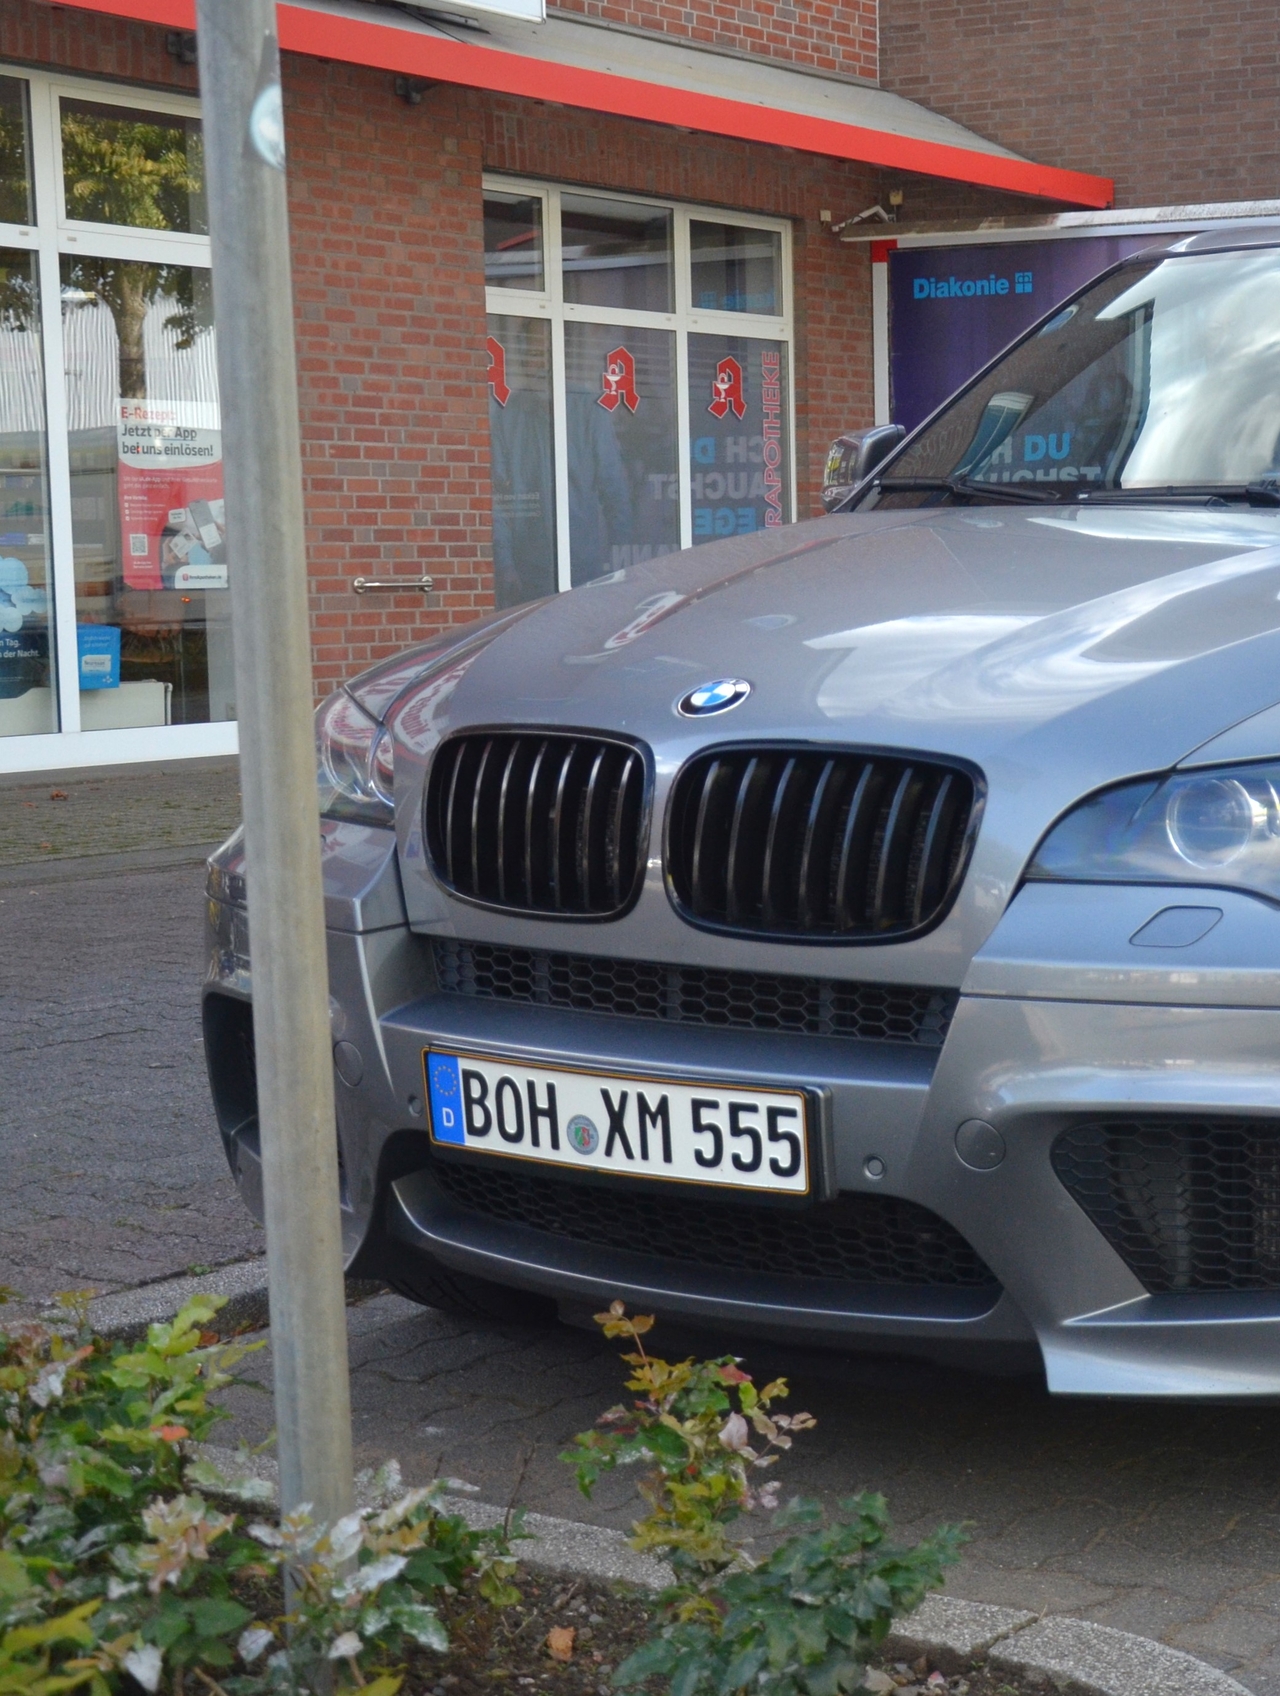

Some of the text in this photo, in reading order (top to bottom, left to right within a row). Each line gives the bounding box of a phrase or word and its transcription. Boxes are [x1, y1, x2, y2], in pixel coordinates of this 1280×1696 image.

[913, 274, 1010, 299] Diakonie
[121, 424, 151, 437] Jetzt
[174, 426, 197, 440] App
[122, 441, 214, 456] bei uns einlösen!
[1023, 432, 1071, 462] DU
[442, 1067, 802, 1178] D BOH XM 555
